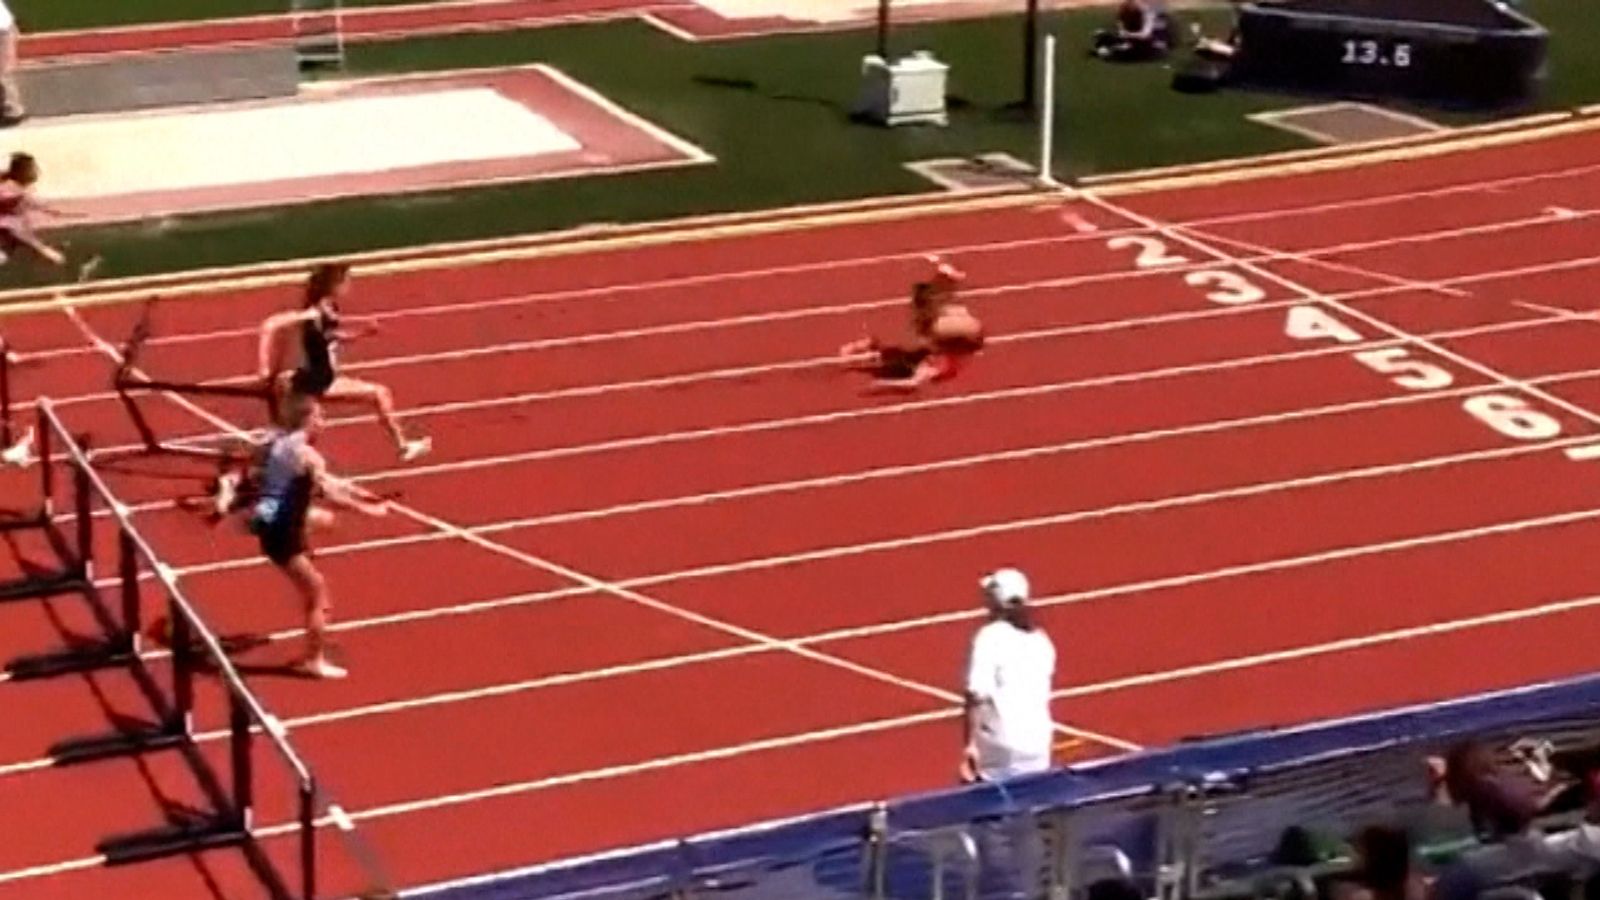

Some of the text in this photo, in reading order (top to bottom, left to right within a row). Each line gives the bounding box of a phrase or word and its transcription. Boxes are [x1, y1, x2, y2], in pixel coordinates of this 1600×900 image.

[1341, 40, 1411, 67] 13.6
[1107, 236, 1189, 267] 2
[1185, 270, 1266, 303] 3
[1285, 305, 1363, 342] 4
[1354, 348, 1454, 389] 5
[1462, 394, 1562, 439] 6
